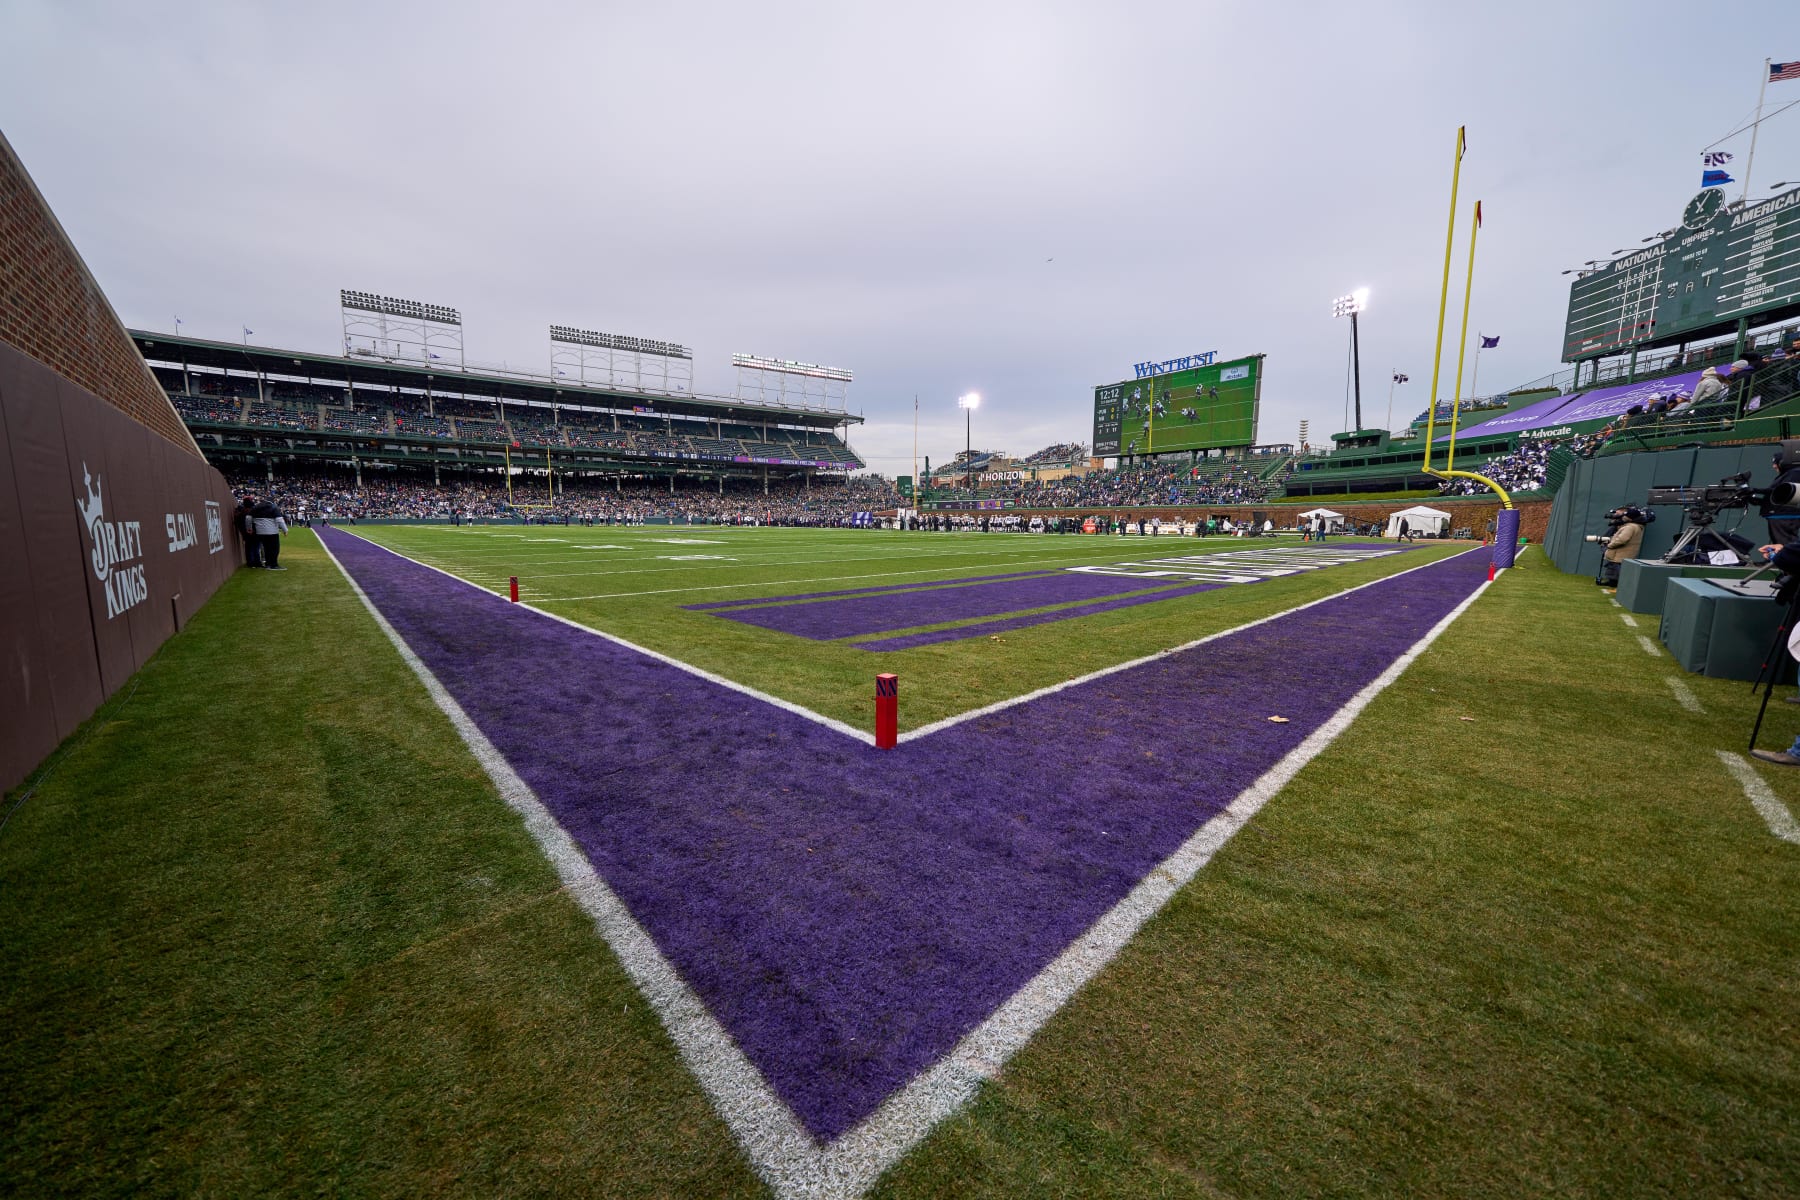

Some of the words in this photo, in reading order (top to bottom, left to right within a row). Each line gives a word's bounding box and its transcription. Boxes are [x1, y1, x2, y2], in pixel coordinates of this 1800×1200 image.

[1615, 244, 1667, 272] NATIONAL
[1133, 350, 1218, 378] WINTRUST
[1100, 388, 1120, 400] 12:12
[1530, 426, 1572, 439] Advocate
[985, 470, 1025, 482] HORIZON
[166, 512, 198, 552] SLOAN
[92, 517, 143, 581] DRAFT
[105, 564, 147, 619] KINGS
